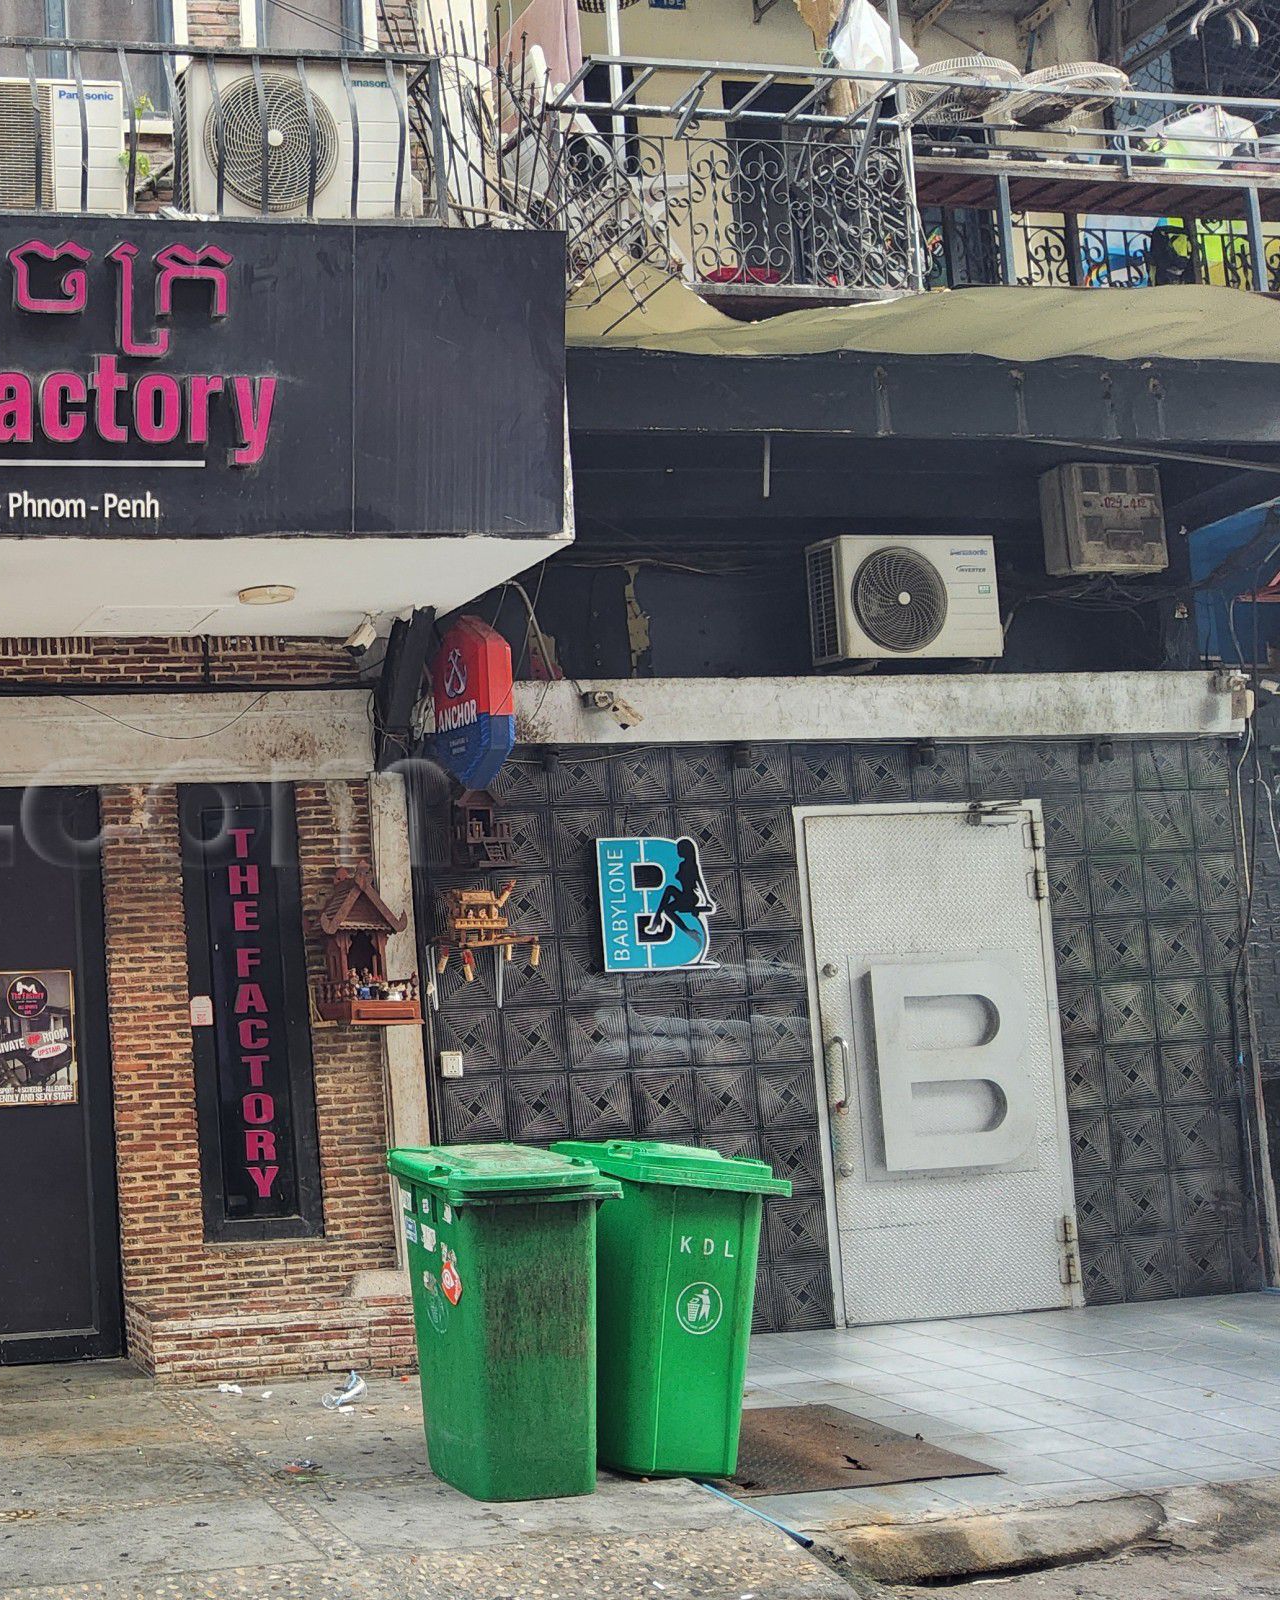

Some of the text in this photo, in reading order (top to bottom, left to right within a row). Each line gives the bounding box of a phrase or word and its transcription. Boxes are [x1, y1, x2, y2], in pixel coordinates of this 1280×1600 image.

[58, 90, 114, 100] Pansonic
[8, 490, 86, 518] Phnom
[104, 491, 160, 518] Penh
[438, 699, 477, 733] ANCHOR
[607, 849, 631, 961] BABYLONE
[226, 828, 280, 1198] THE FACTORY
[41, 1027, 69, 1043] ROOM
[20, 1093, 34, 1102] AND
[35, 1092, 53, 1101] SEXY
[53, 1091, 73, 1100] STAFF
